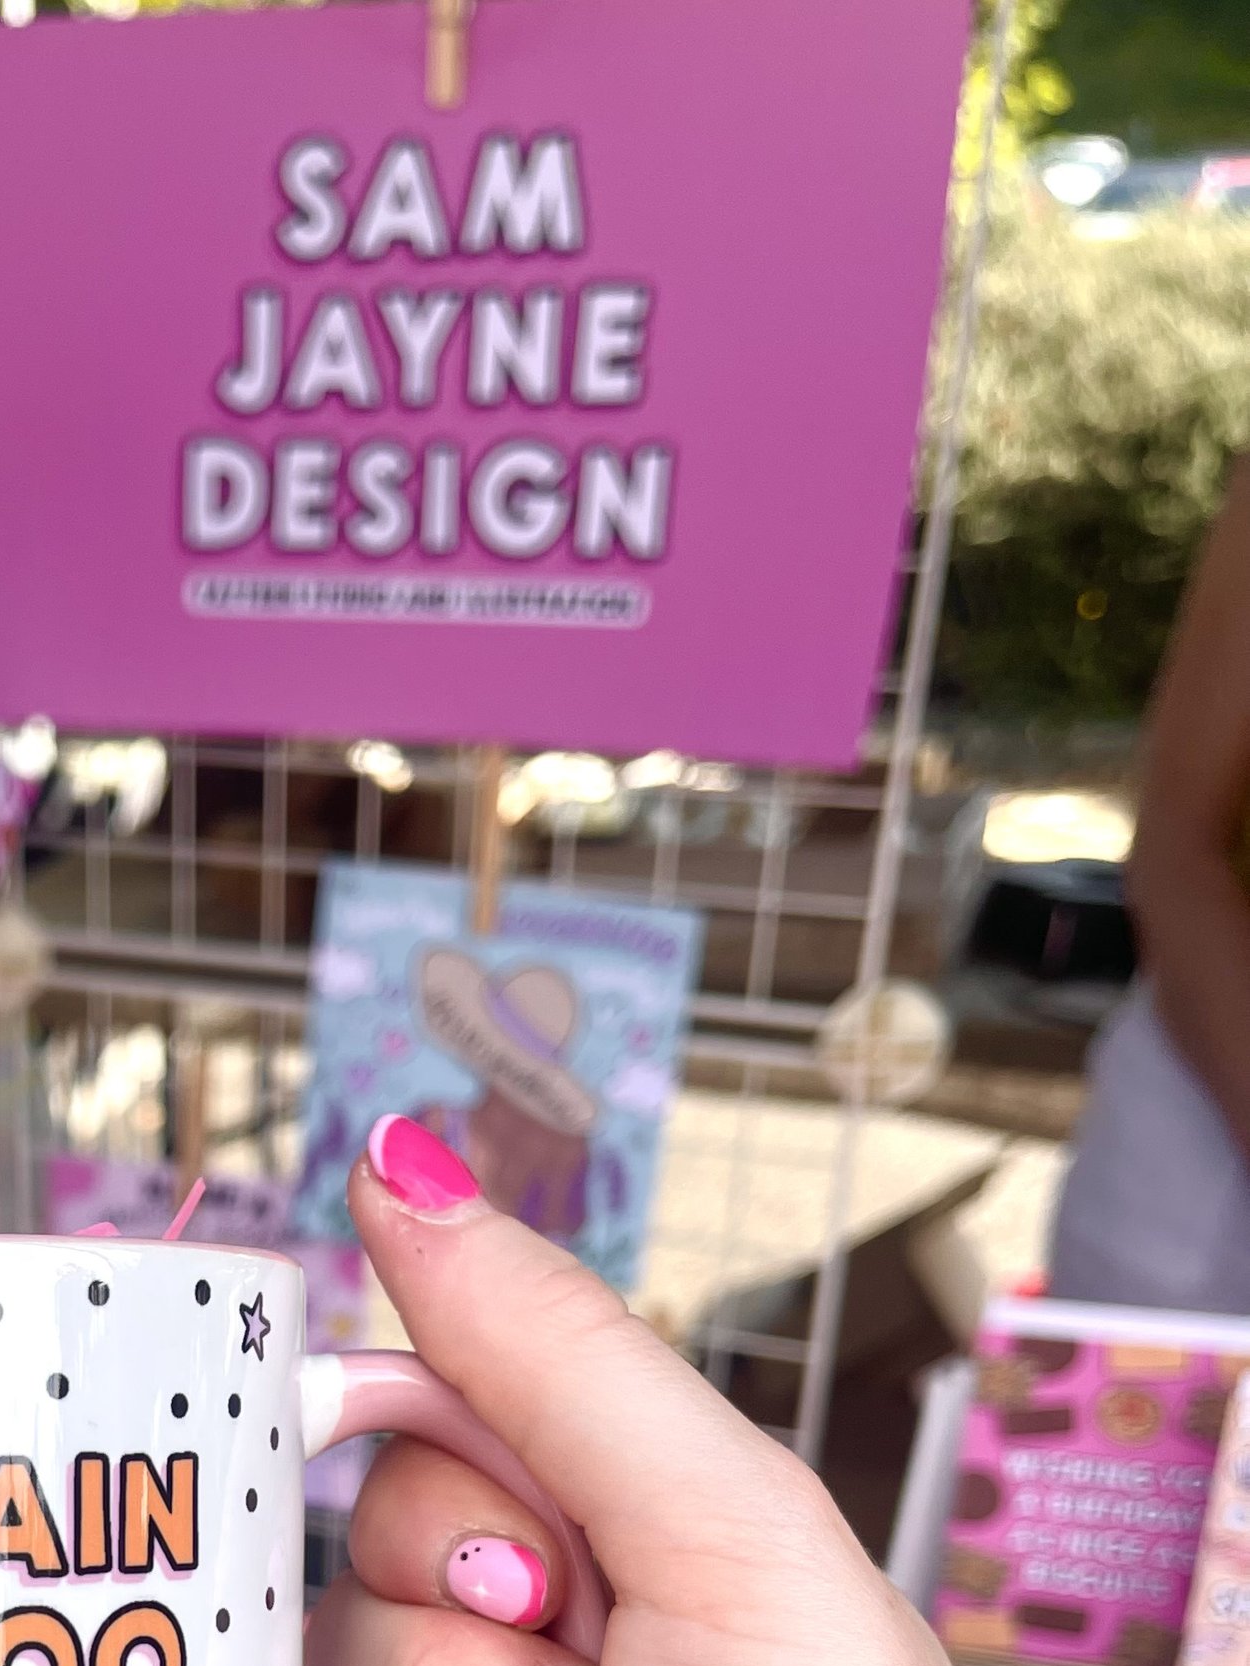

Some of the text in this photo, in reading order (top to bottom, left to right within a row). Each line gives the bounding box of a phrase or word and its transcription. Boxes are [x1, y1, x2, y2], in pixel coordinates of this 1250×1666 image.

[275, 132, 586, 260] SAM
[216, 282, 652, 415] JAYNE
[179, 435, 674, 561] DESIGN
